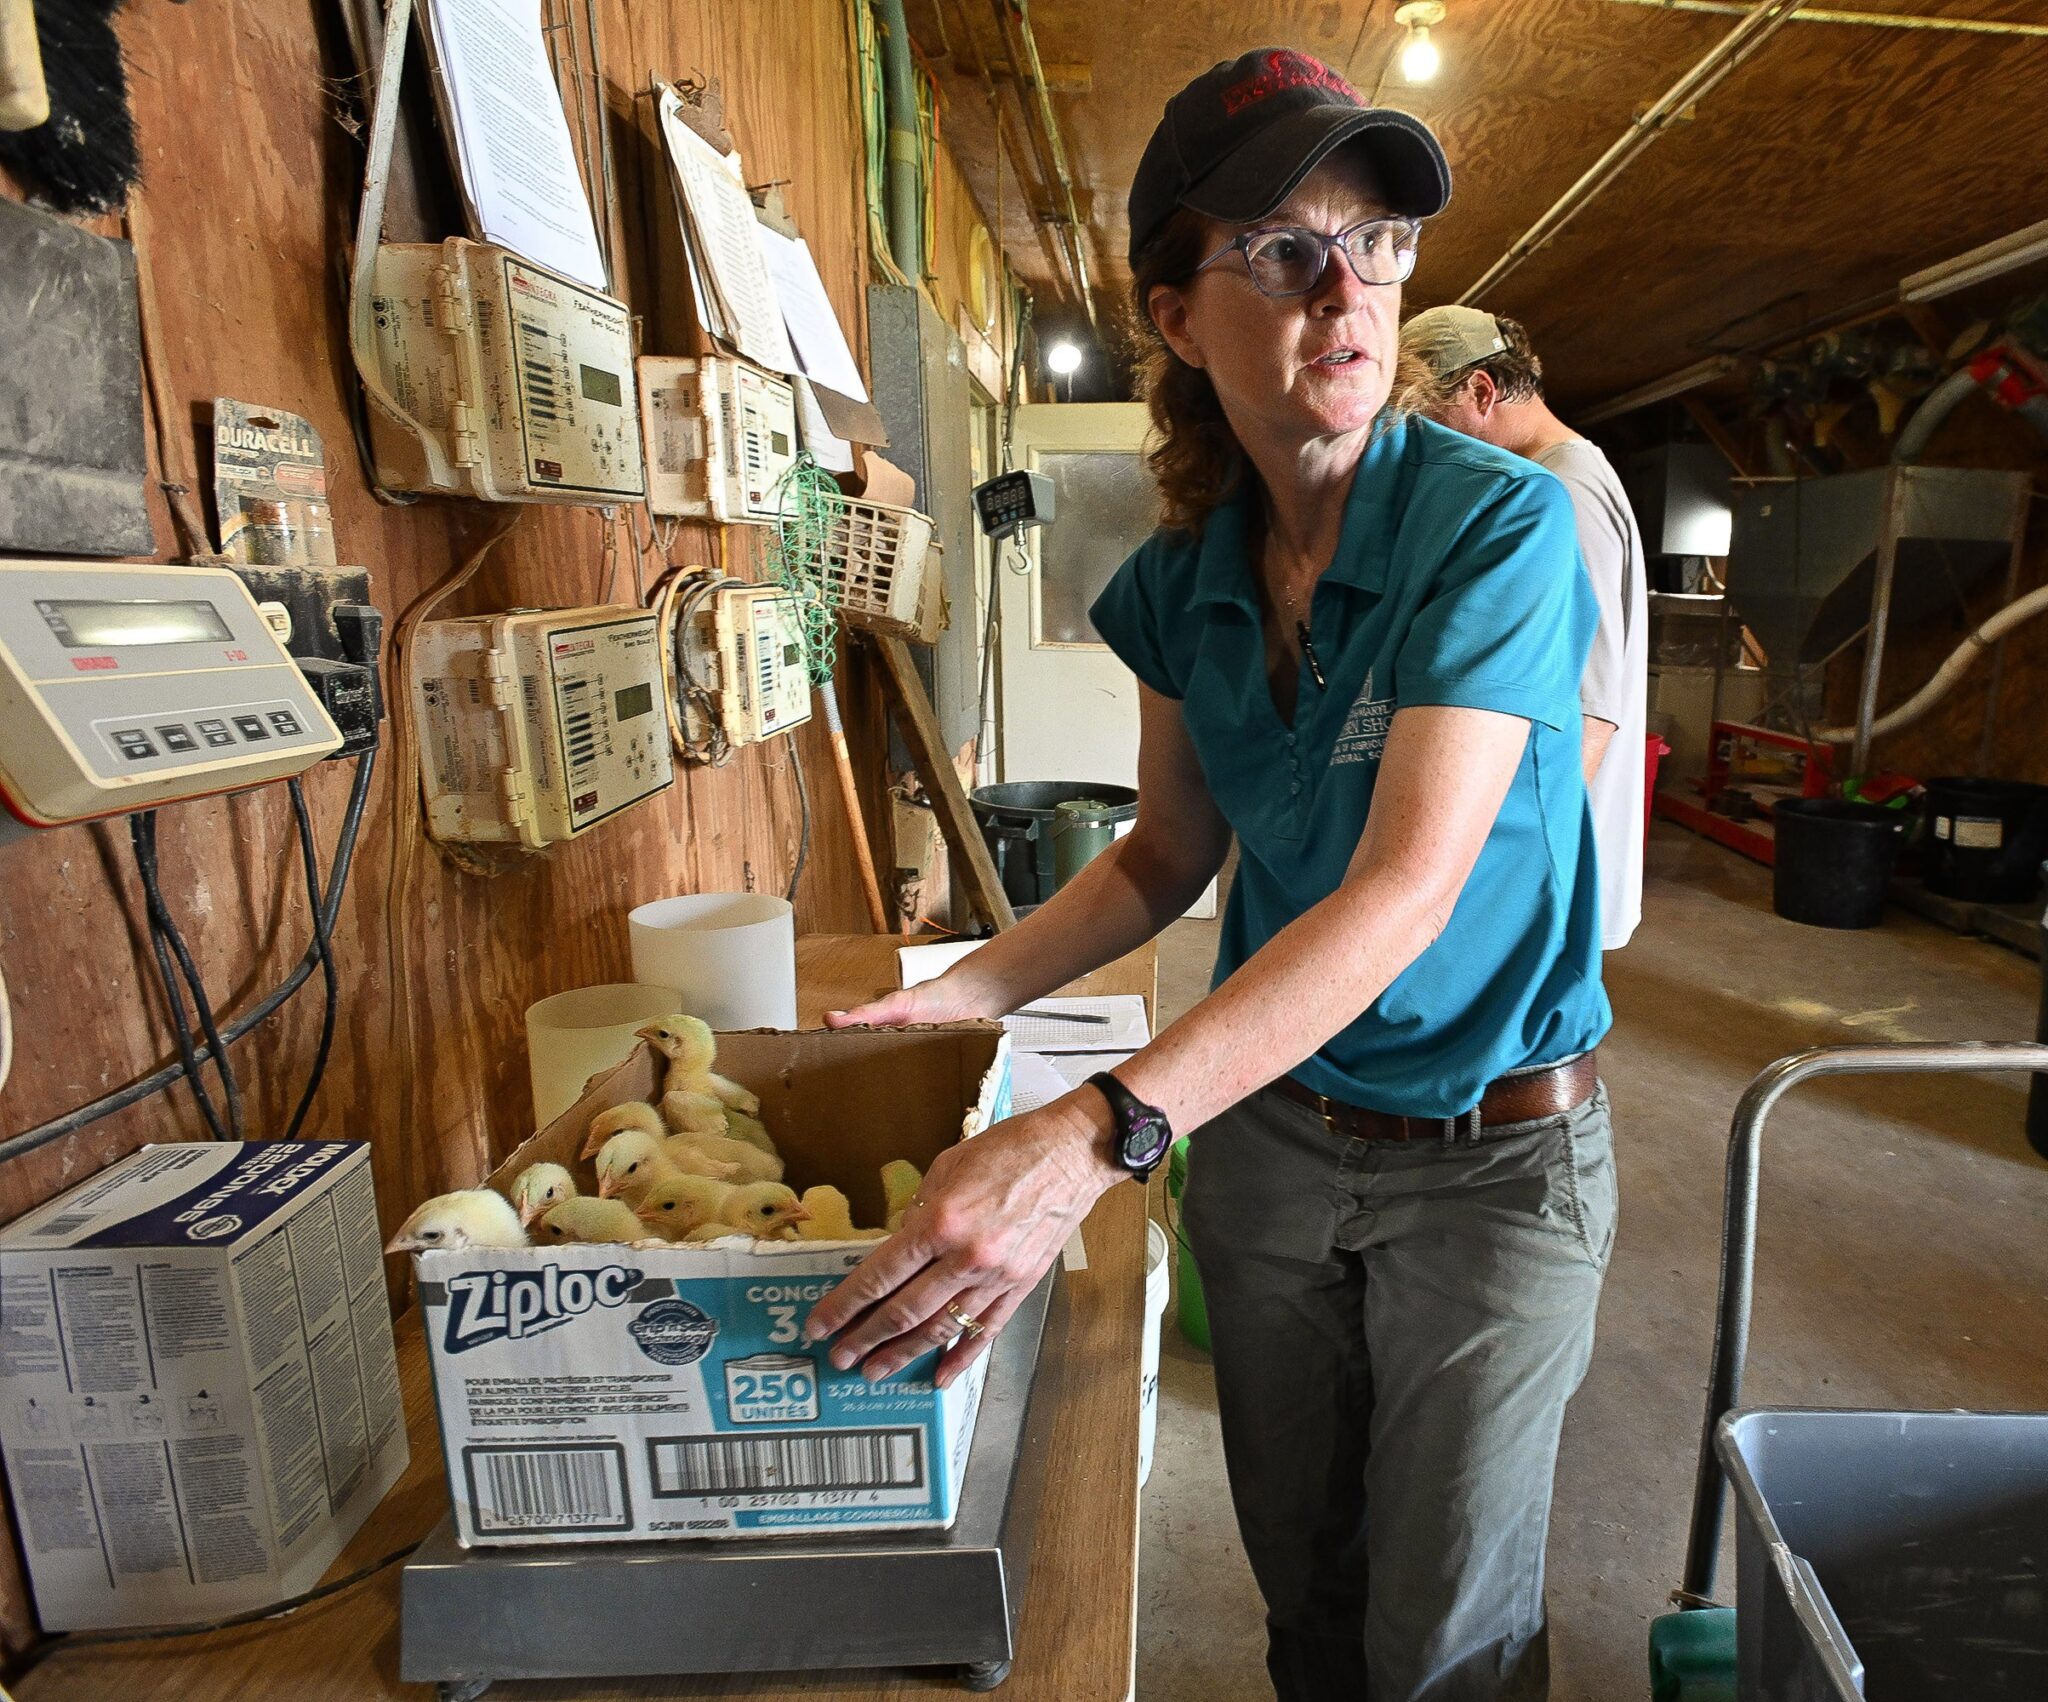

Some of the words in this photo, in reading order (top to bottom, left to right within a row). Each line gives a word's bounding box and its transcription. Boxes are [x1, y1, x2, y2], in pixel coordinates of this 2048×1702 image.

[217, 425, 314, 458] DURACELL
[255, 1143, 351, 1195] MOLDEX
[169, 1143, 307, 1222] 2200N95
[449, 1263, 628, 1340] Ziploc
[464, 1378, 490, 1386] POUR
[733, 1373, 813, 1405] 250
[869, 1381, 935, 1397] LITRES
[518, 1406, 543, 1414] POUR
[741, 1403, 810, 1420] UNITÉS
[700, 1497, 709, 1508] 1
[718, 1496, 740, 1508] 00
[750, 1493, 800, 1507] 25700
[809, 1491, 860, 1504] 71377
[507, 1514, 552, 1526] 25700
[558, 1513, 601, 1524] 71377
[758, 1511, 841, 1524] EMBALLAGE
[842, 1508, 933, 1521] COMMERCIAL
